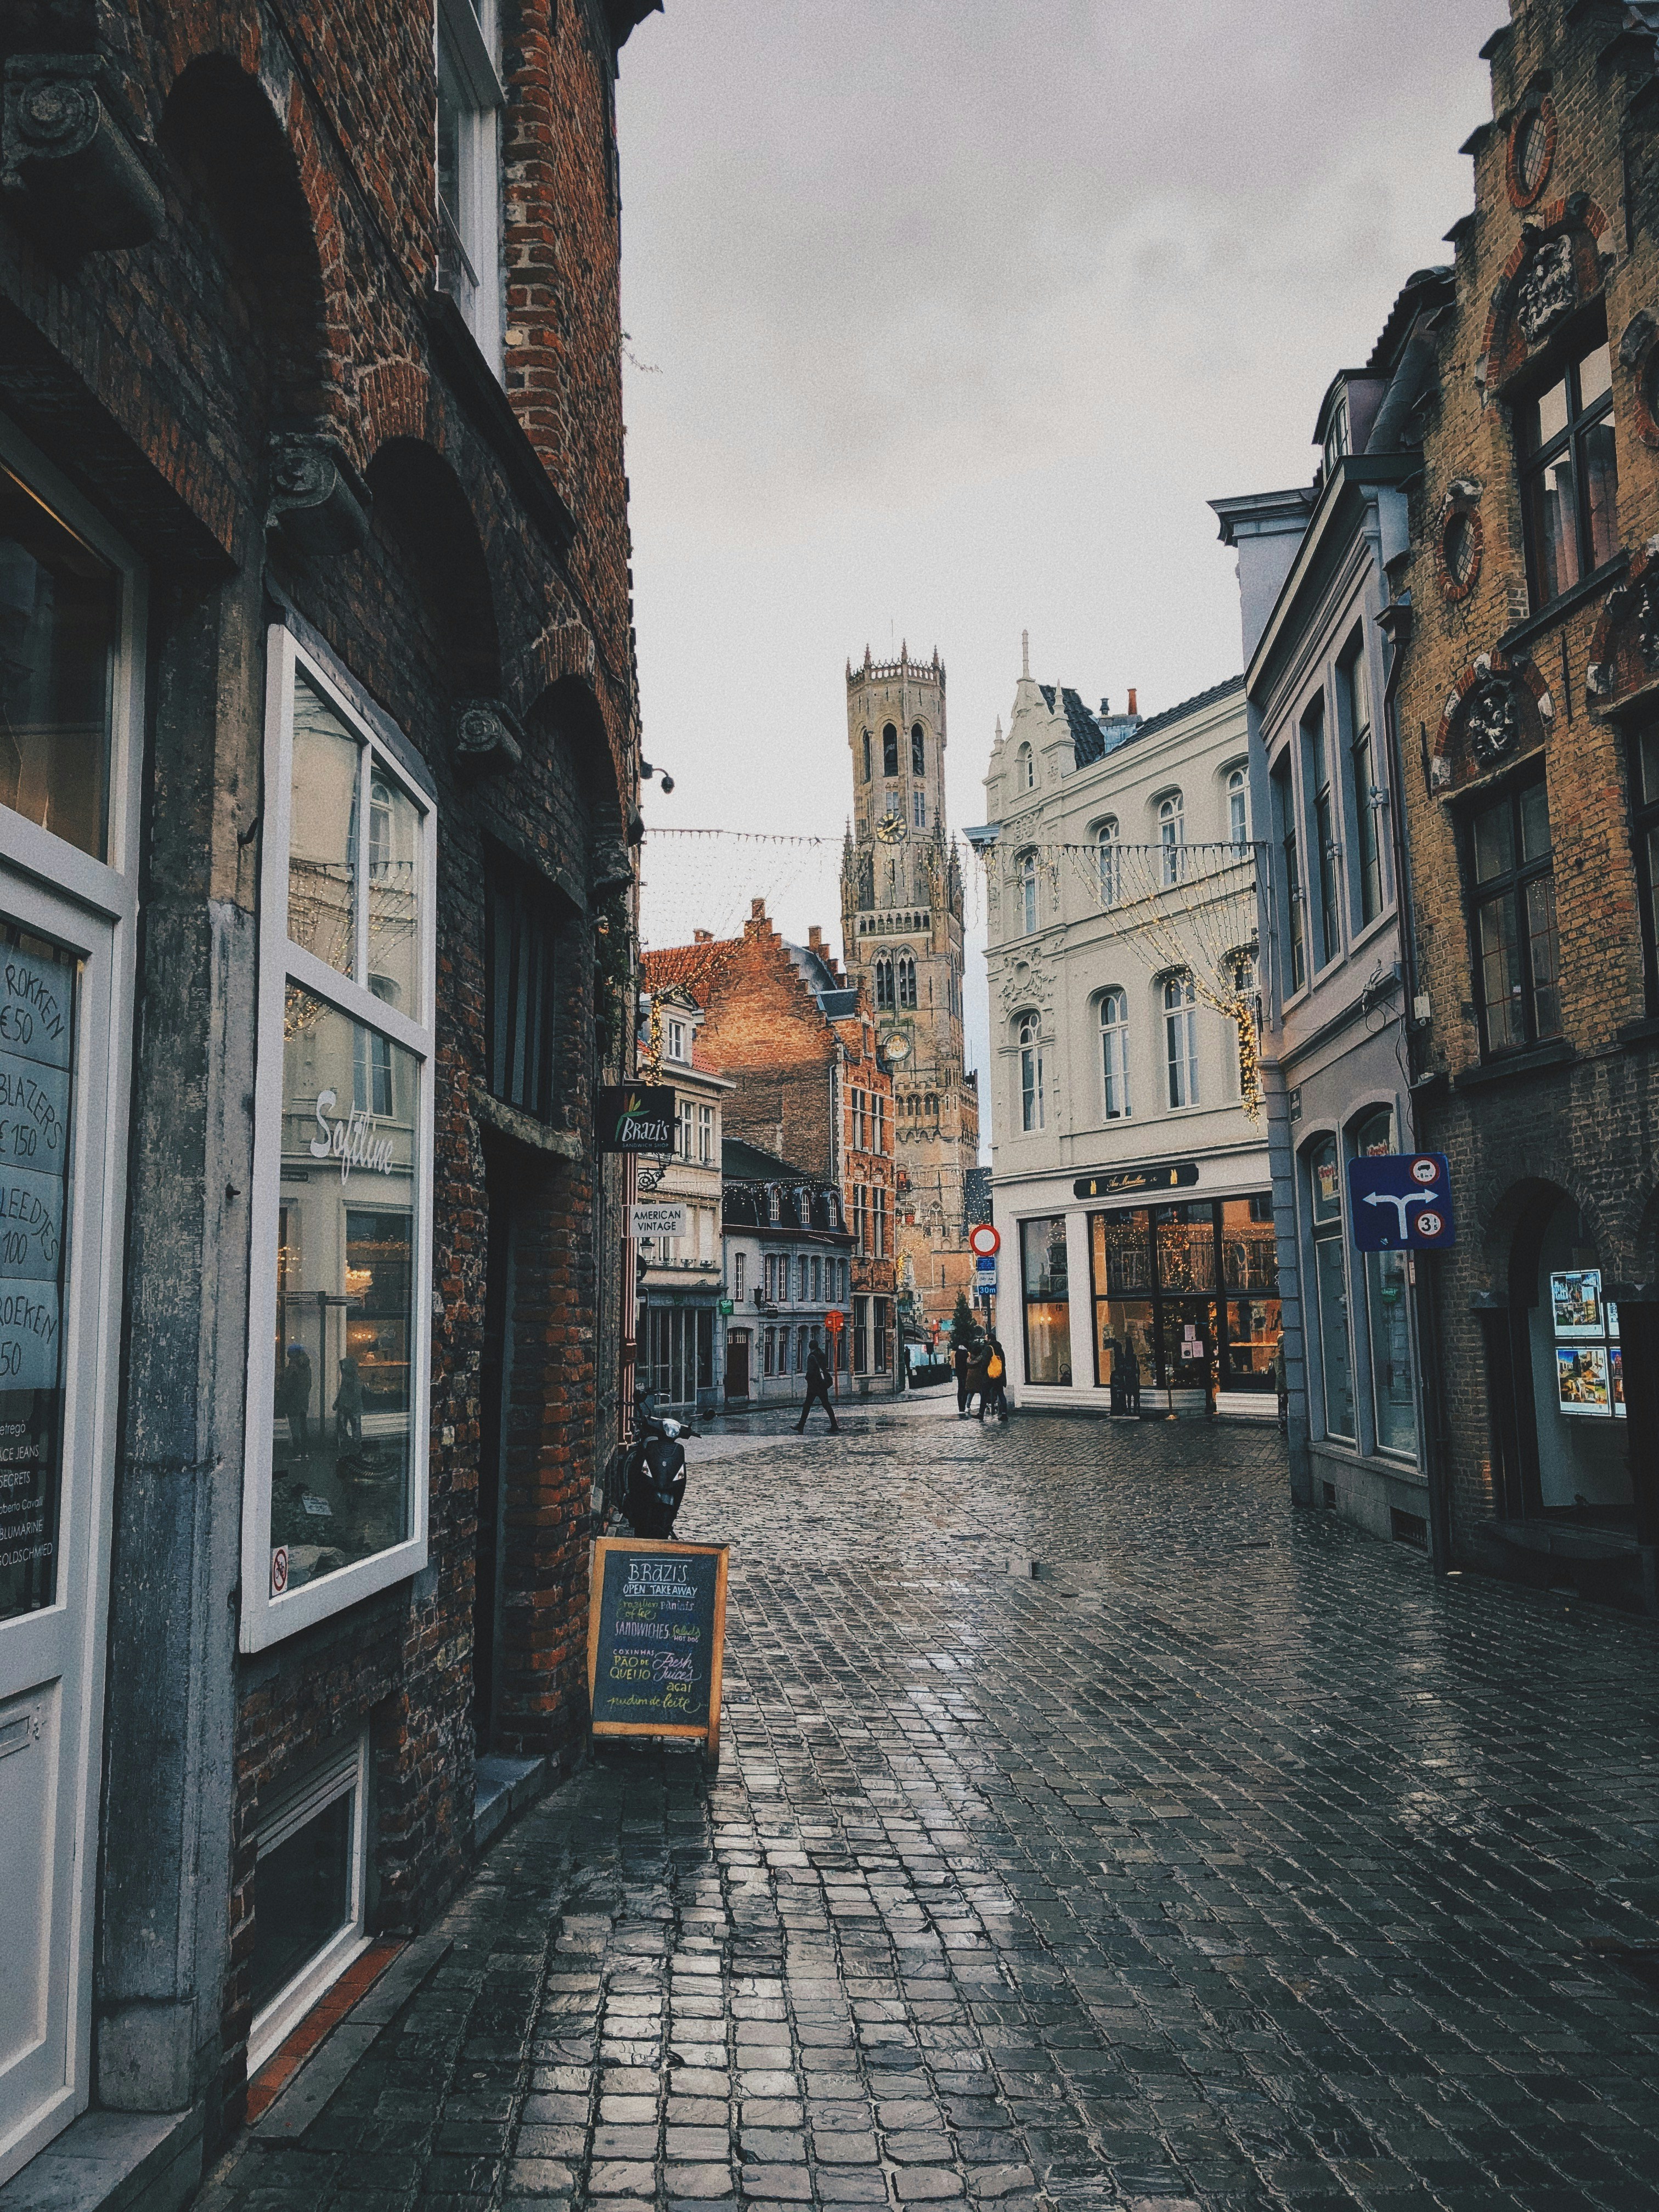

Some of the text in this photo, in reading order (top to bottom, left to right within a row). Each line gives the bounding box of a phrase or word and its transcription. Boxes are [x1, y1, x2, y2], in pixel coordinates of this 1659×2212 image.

[5, 964, 65, 1040] ROKKEN
[634, 1210, 681, 1220] AMERICAN
[638, 1222, 676, 1231] VINTAGE
[3, 1231, 27, 1265] 100
[15, 1444, 39, 1460] JEANS
[0, 1519, 43, 1541] BLUMARINE
[623, 1584, 646, 1594] OPEN
[610, 1667, 651, 1680] QUEIJO
